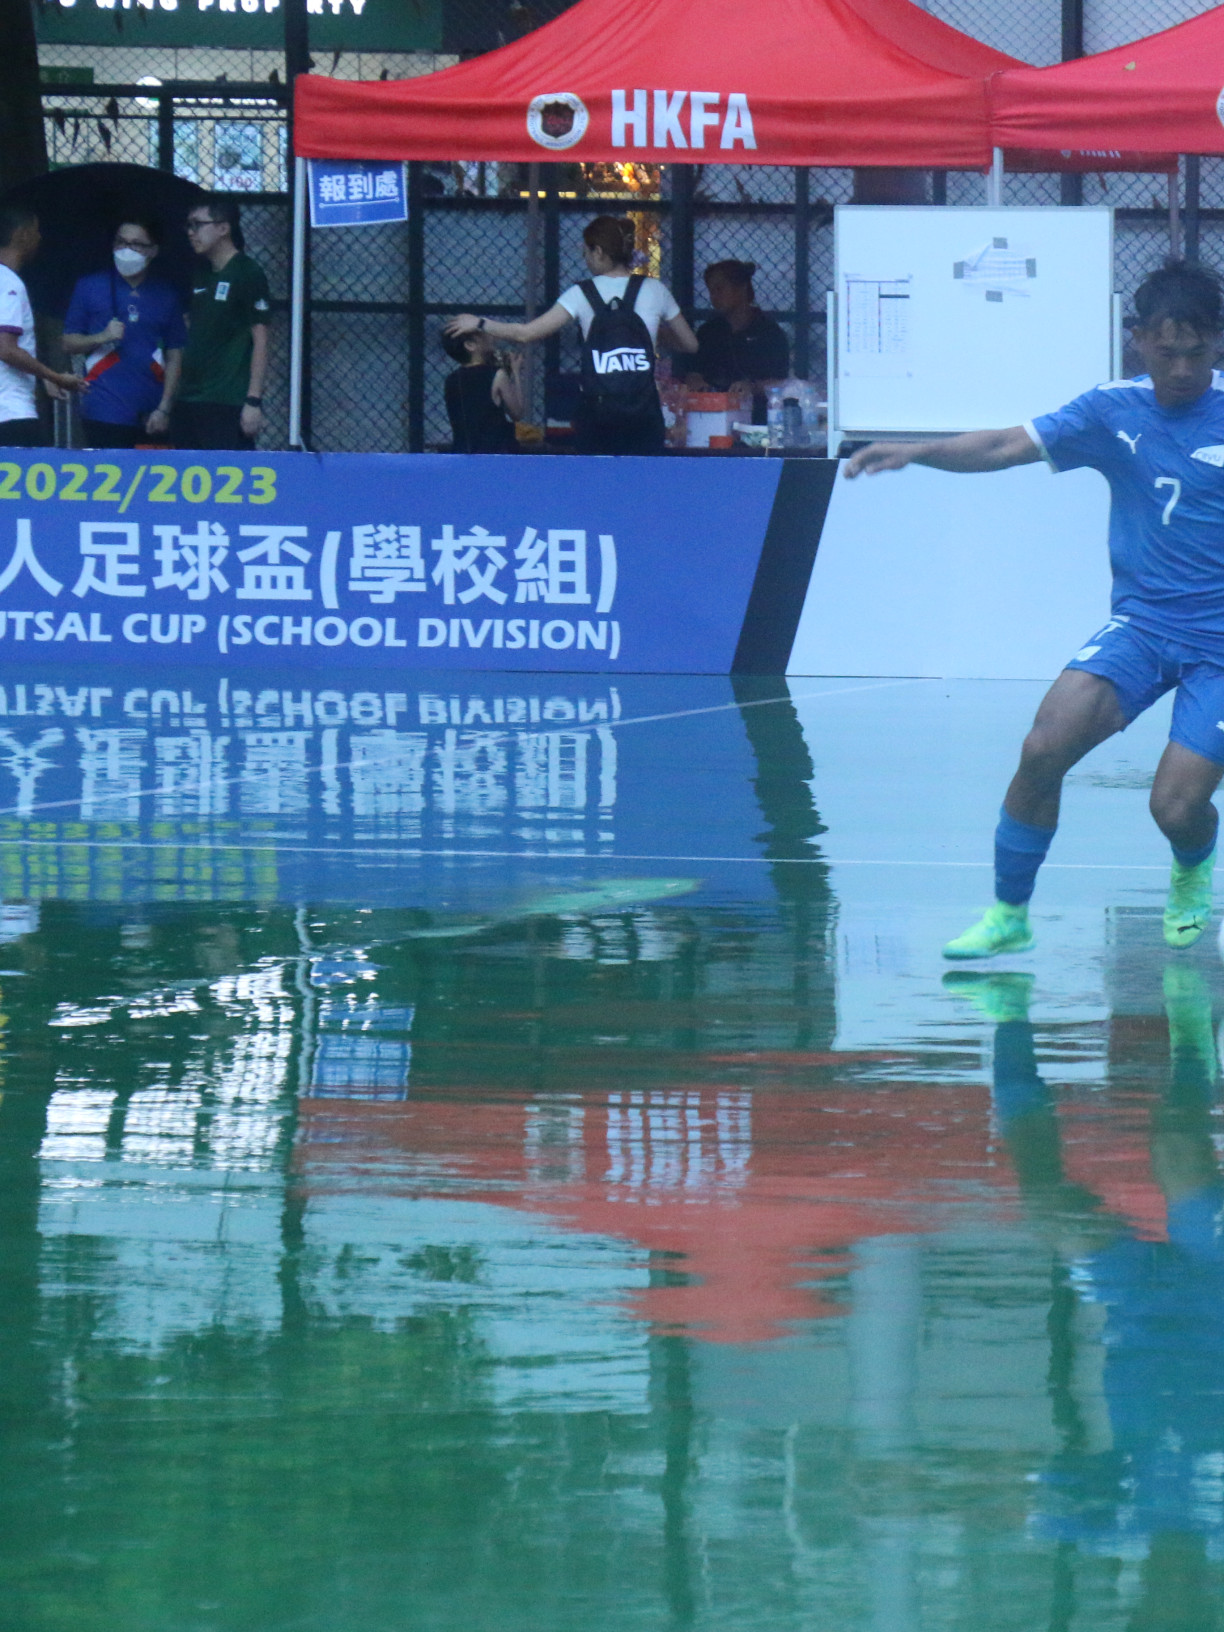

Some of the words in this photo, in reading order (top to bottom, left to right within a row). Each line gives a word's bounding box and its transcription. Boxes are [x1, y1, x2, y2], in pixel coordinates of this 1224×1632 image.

[198, 0, 367, 15] PROPRTY
[611, 89, 758, 150] HKFA
[318, 170, 399, 203] 報到處
[591, 347, 651, 375] VANS
[0, 462, 278, 513] 2022/2023
[1154, 476, 1181, 526] 7
[0, 518, 618, 613] 人足球盃(學校組)
[0, 611, 113, 642] TSAL
[122, 613, 207, 644] CUP
[218, 615, 407, 654] (SCHOOL
[418, 618, 620, 660] DIVISION)
